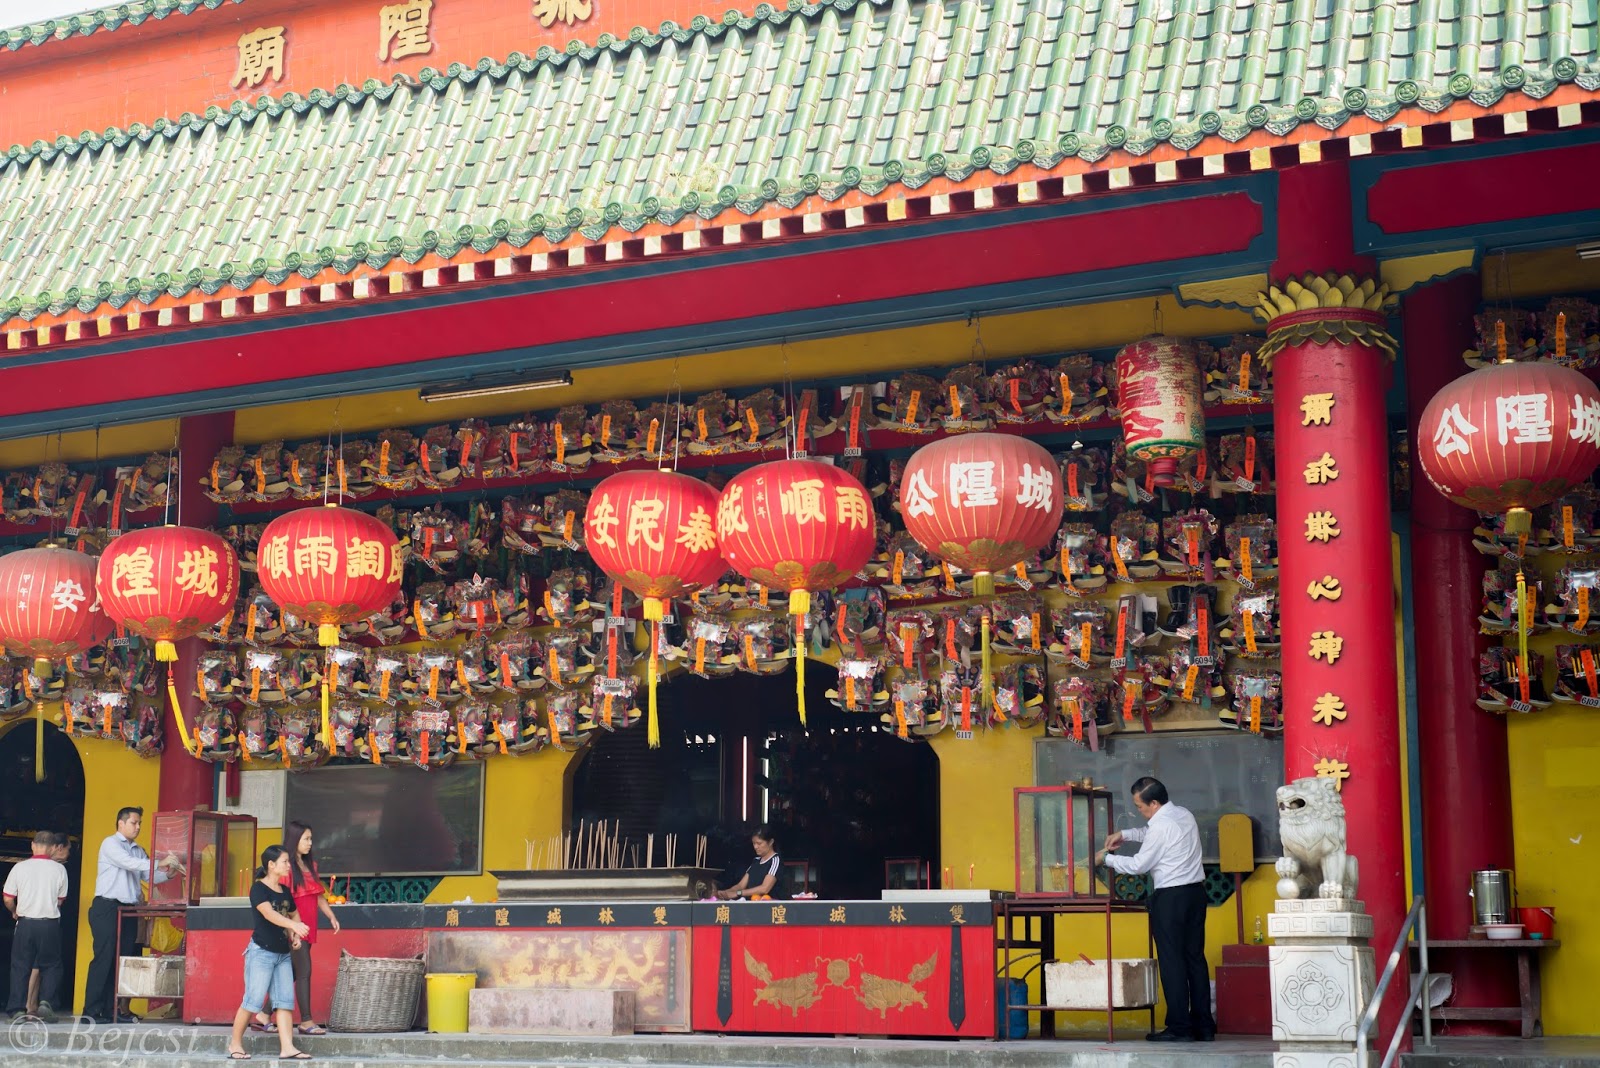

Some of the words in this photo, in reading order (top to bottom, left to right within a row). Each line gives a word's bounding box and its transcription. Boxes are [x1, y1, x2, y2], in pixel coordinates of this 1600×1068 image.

[1513, 700, 1529, 711] 6110
[1582, 696, 1599, 707] 6109
[956, 731, 972, 739] 6117
